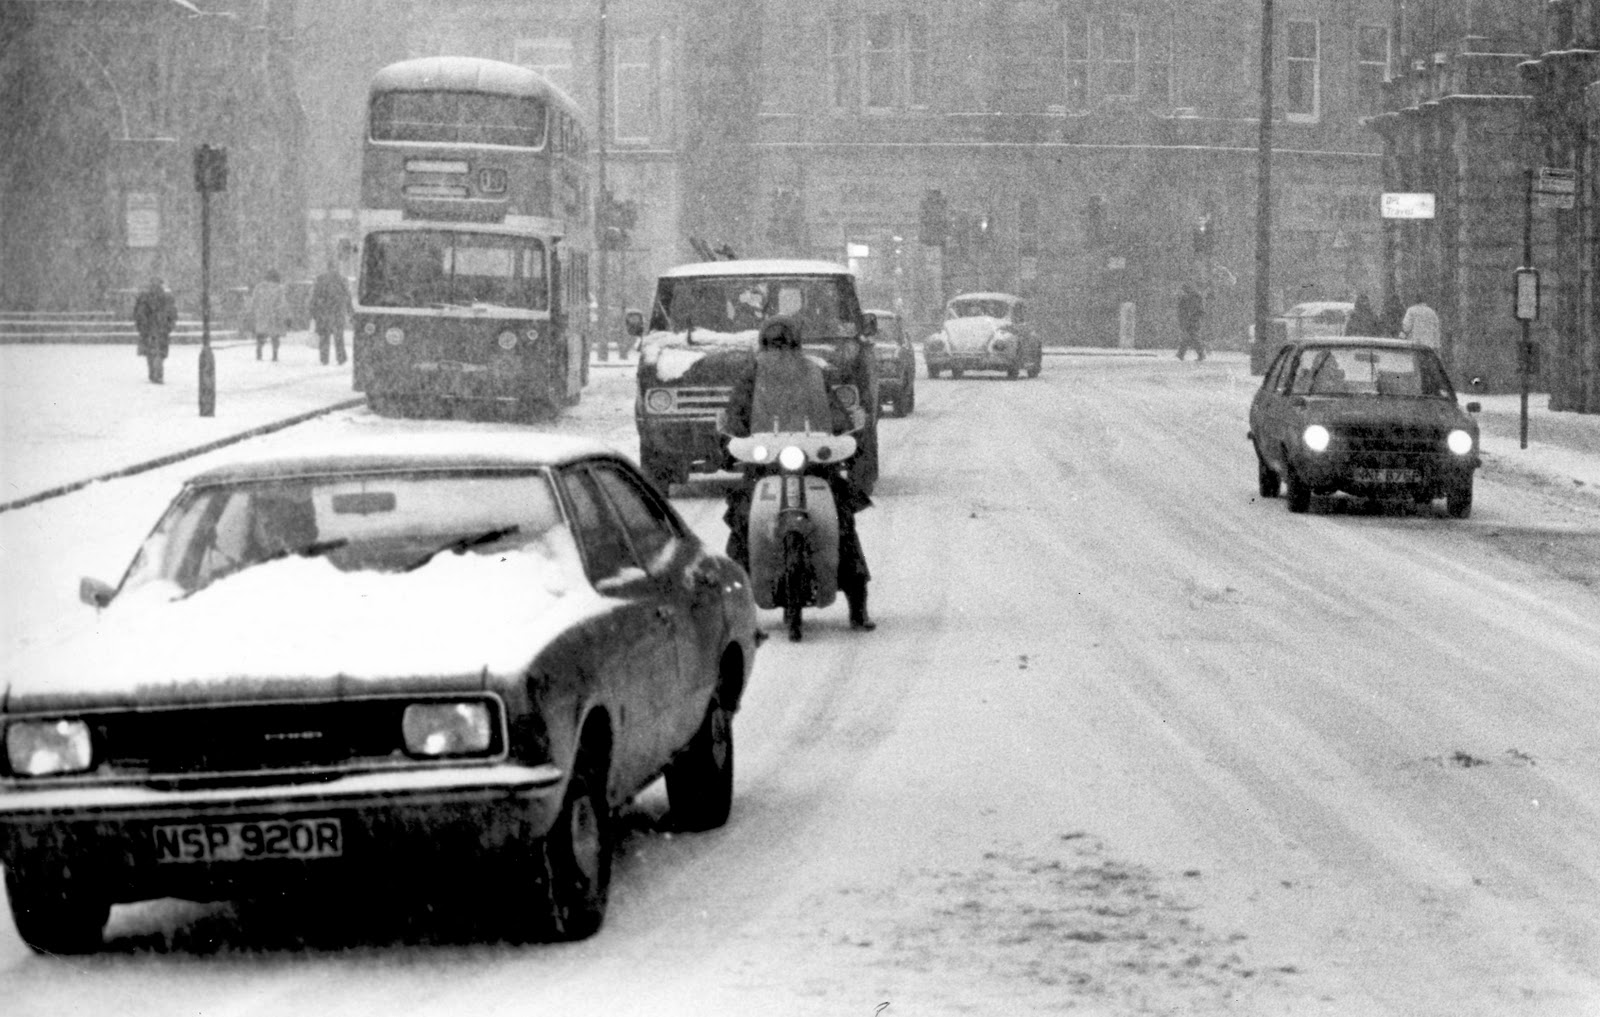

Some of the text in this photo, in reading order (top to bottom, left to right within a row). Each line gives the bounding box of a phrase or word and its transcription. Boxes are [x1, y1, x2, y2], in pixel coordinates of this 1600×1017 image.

[1386, 207, 1414, 216] Travel
[761, 482, 777, 501] L
[156, 822, 339, 859] NSP 920R
